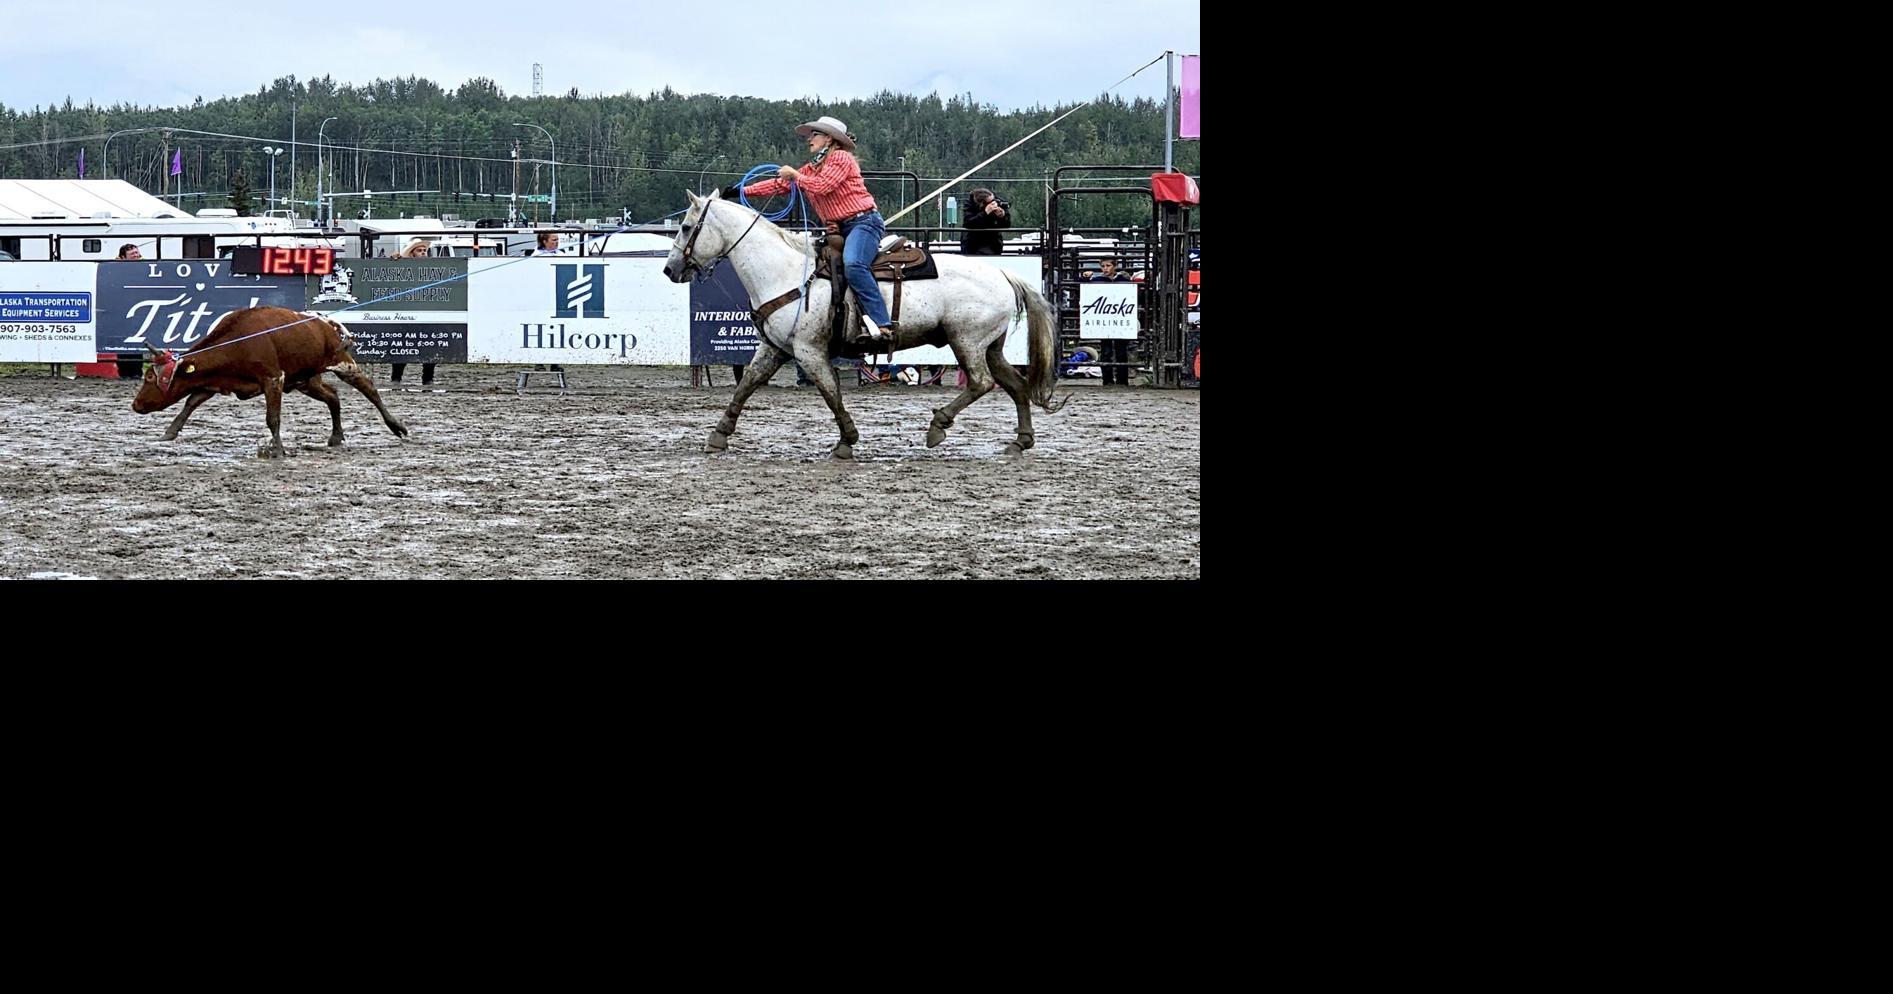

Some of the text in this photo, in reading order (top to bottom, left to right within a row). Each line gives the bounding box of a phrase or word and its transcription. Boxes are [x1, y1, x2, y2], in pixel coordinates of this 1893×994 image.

[149, 264, 261, 282] LOV,
[361, 267, 414, 281] ALASKA
[418, 267, 446, 281] HAY
[371, 287, 452, 302] FEED SUPPLY
[0, 298, 23, 306] LASKA
[1082, 296, 1135, 317] Alaska
[362, 312, 391, 321] Business
[0, 324, 76, 333] 907-903-7563
[1085, 319, 1131, 327] AIRLINES
[717, 326, 727, 337] &
[520, 323, 638, 358] Hilcorp
[356, 347, 388, 358] Sunday:
